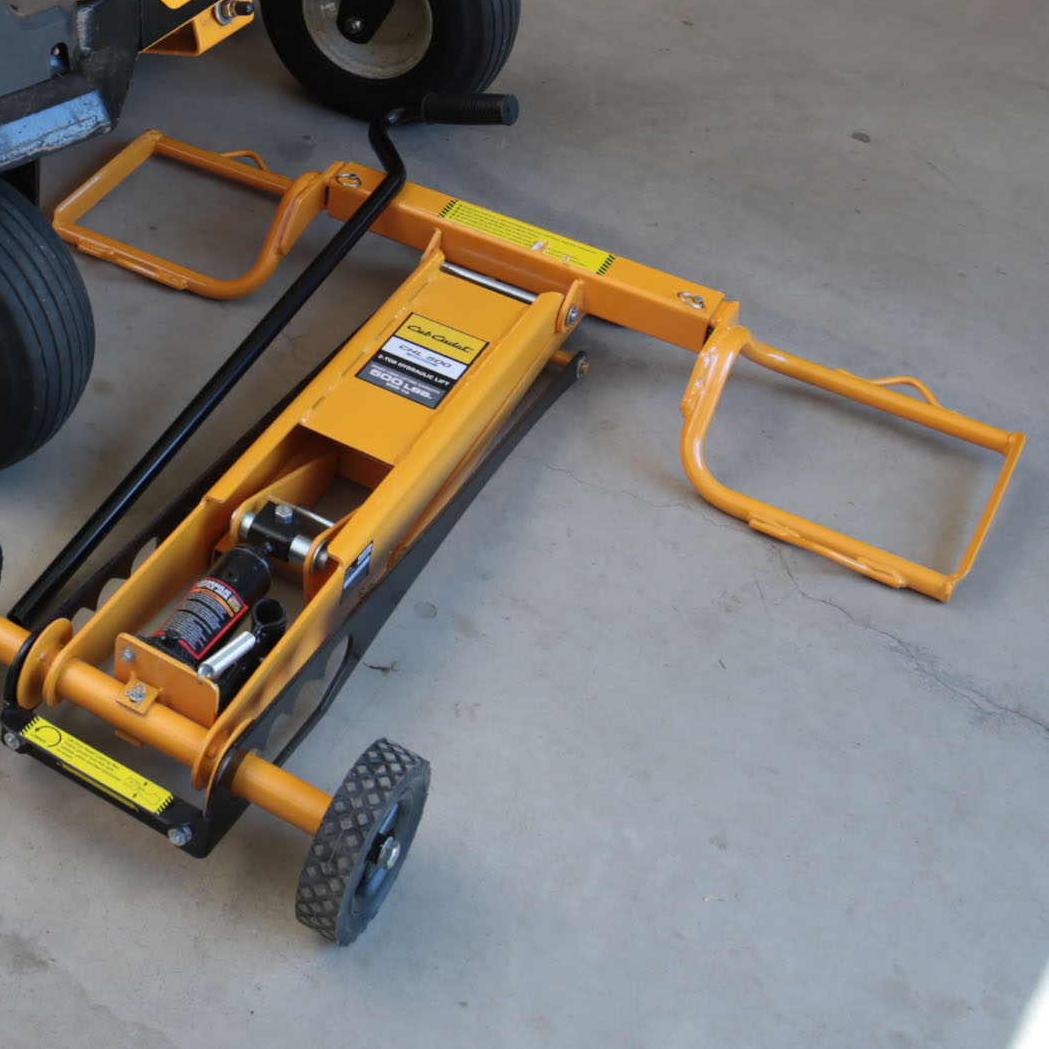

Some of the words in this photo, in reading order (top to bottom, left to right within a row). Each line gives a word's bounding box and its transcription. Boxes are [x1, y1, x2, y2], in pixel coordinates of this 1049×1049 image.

[407, 325, 432, 337] Cub
[431, 334, 474, 354] Cadet
[399, 344, 422, 356] CHL
[426, 355, 452, 368] 500
[369, 368, 404, 386] 500
[398, 361, 434, 380] HYDRAULIC
[434, 376, 450, 387] LIFT
